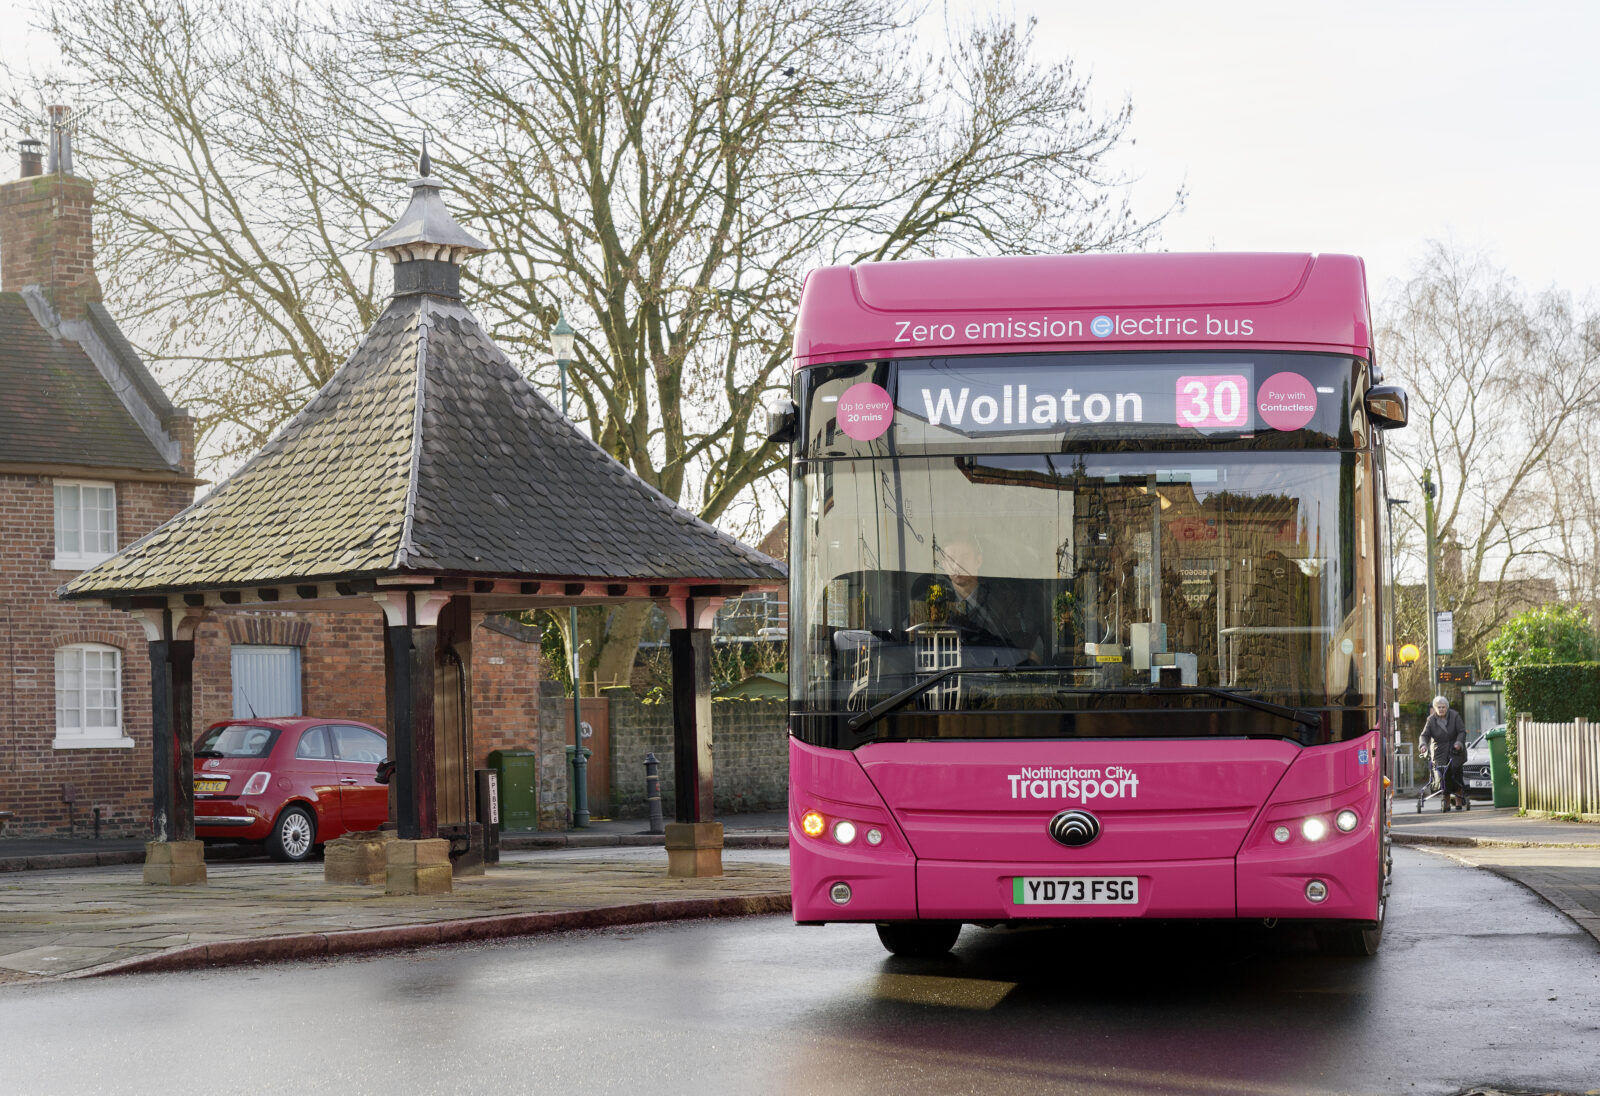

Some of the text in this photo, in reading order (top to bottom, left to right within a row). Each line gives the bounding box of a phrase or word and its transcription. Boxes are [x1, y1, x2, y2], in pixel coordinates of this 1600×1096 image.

[895, 313, 1254, 343] Zero emission electric bus
[921, 380, 1242, 426] Wollaton 30
[1269, 392, 1306, 402] Pay with
[841, 402, 853, 412] Up
[866, 402, 890, 410] every
[1260, 403, 1314, 412] Contactless
[848, 413, 882, 422] 20 mins
[1021, 766, 1133, 783] Nottingham City
[1008, 773, 1139, 804] Transport
[1028, 880, 1134, 901] YD73 FSG
